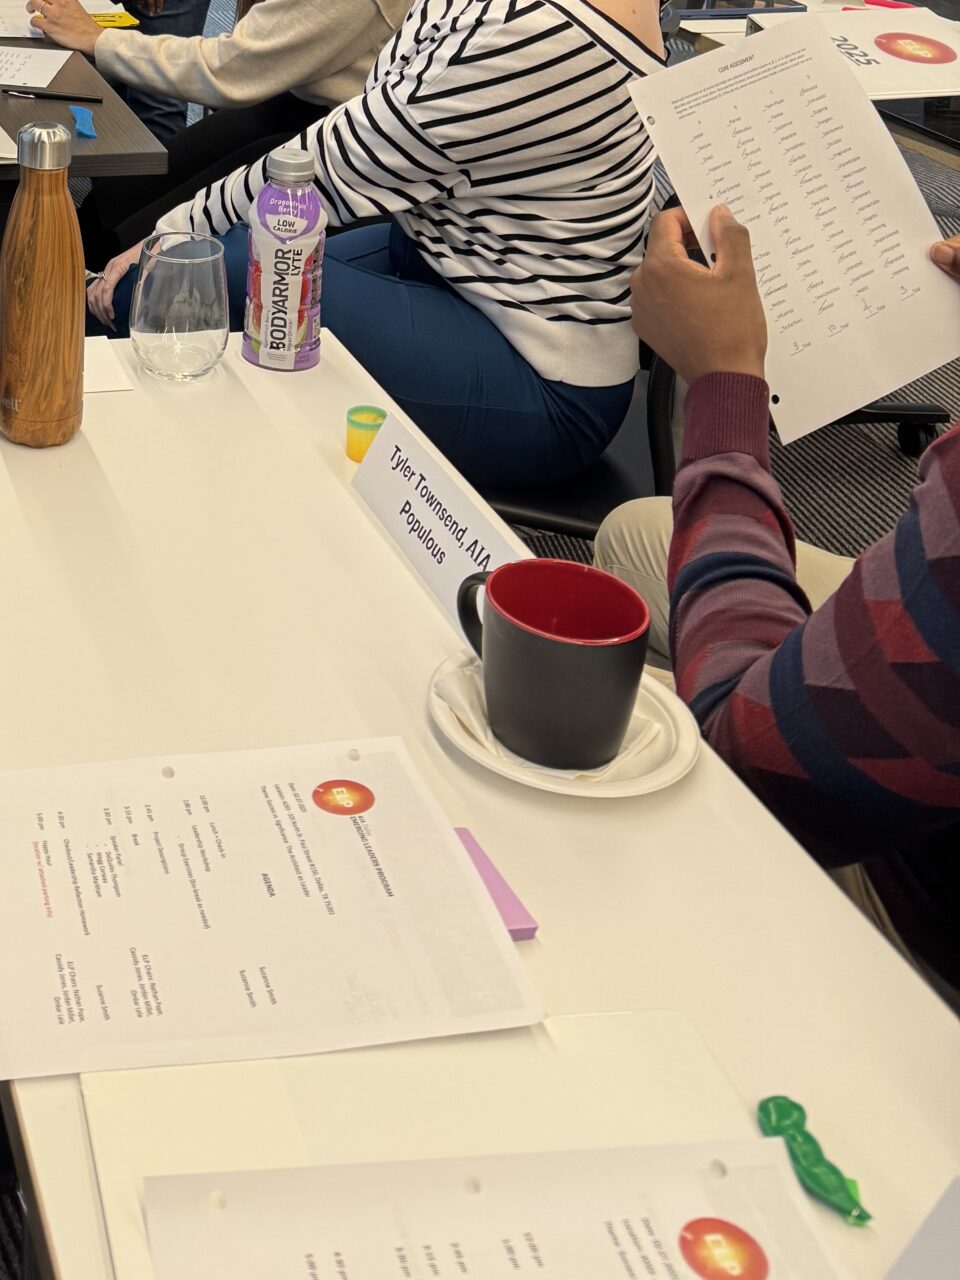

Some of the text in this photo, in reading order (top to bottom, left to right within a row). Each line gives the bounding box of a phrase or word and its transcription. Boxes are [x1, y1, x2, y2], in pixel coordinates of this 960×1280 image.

[830, 35, 881, 66] 2025
[273, 225, 298, 234] CALORIE
[277, 218, 296, 228] LOW
[290, 248, 303, 276] LYTE
[269, 247, 292, 351] BODYARMOR
[390, 444, 493, 572] Tyler Townsend, AIA
[399, 499, 446, 566] Populous
[331, 786, 355, 808] ELP
[130, 833, 140, 846] Break
[208, 821, 218, 834] Lunch
[109, 835, 124, 866] Speaker Panel
[151, 831, 170, 874] Project Descriptions
[190, 824, 203, 848] Leadership
[198, 849, 211, 872] Workshop
[285, 845, 294, 853] The
[298, 839, 308, 849] Paul
[302, 849, 314, 863] Street
[349, 816, 394, 897] EMERGING LEADERS PROGRAM
[45, 855, 53, 866] Hour
[288, 854, 303, 875] Architect
[86, 852, 103, 897] Samantha Markham
[109, 873, 122, 897] Thompson
[177, 843, 187, 857] Group
[182, 857, 194, 878] Exercises
[198, 909, 211, 929] needed)
[261, 873, 276, 897] AGENDA
[73, 885, 84, 909] Reflection
[299, 881, 311, 897] Leader
[323, 900, 335, 915] 75201
[78, 909, 91, 936] Homework
[66, 960, 74, 970] ELP
[72, 989, 82, 1007] Nathan
[141, 954, 150, 963] ELP
[149, 982, 160, 1001] Nathan
[237, 969, 257, 1007] Suzanne Smith
[257, 966, 278, 1005] Suzanne Smith
[95, 984, 110, 1020] Suzanne Smith
[138, 983, 149, 1000] Jordan
